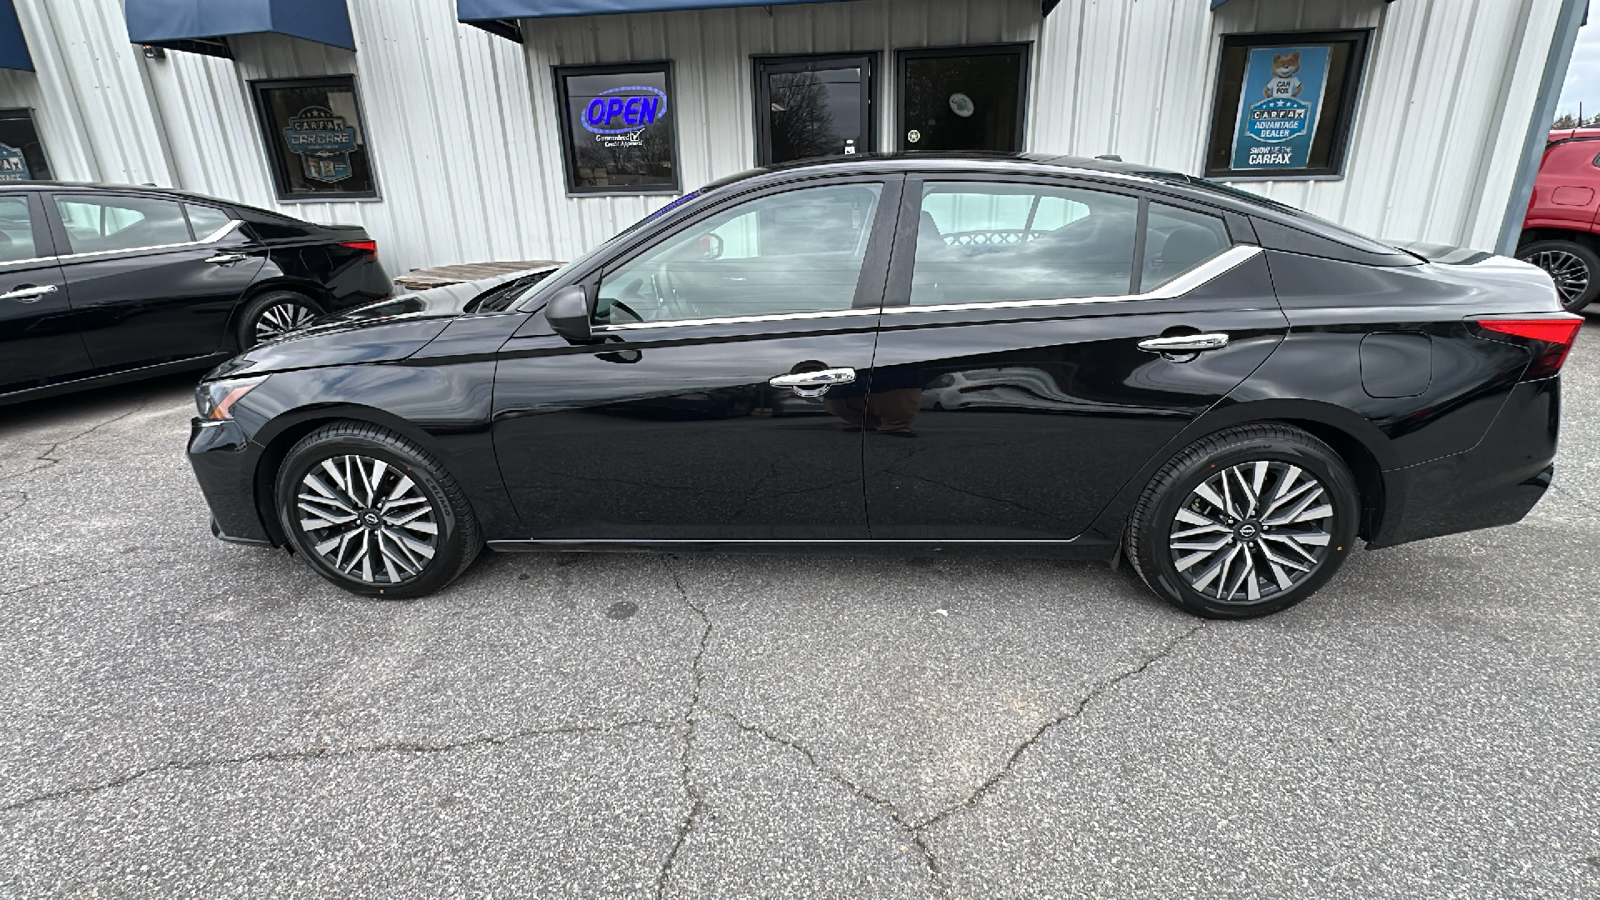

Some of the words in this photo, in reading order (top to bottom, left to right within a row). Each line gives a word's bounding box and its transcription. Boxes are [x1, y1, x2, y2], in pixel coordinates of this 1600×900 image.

[586, 96, 659, 125] OPEN
[1253, 110, 1304, 119] CARFAX
[294, 121, 344, 131] CARFAX
[1254, 120, 1299, 129] ADVANTAGE
[1260, 129, 1290, 138] DEALER
[291, 134, 316, 144] CAR
[317, 133, 349, 143] CARE
[1249, 146, 1270, 154] SHOW
[1248, 153, 1291, 165] CARFAX
